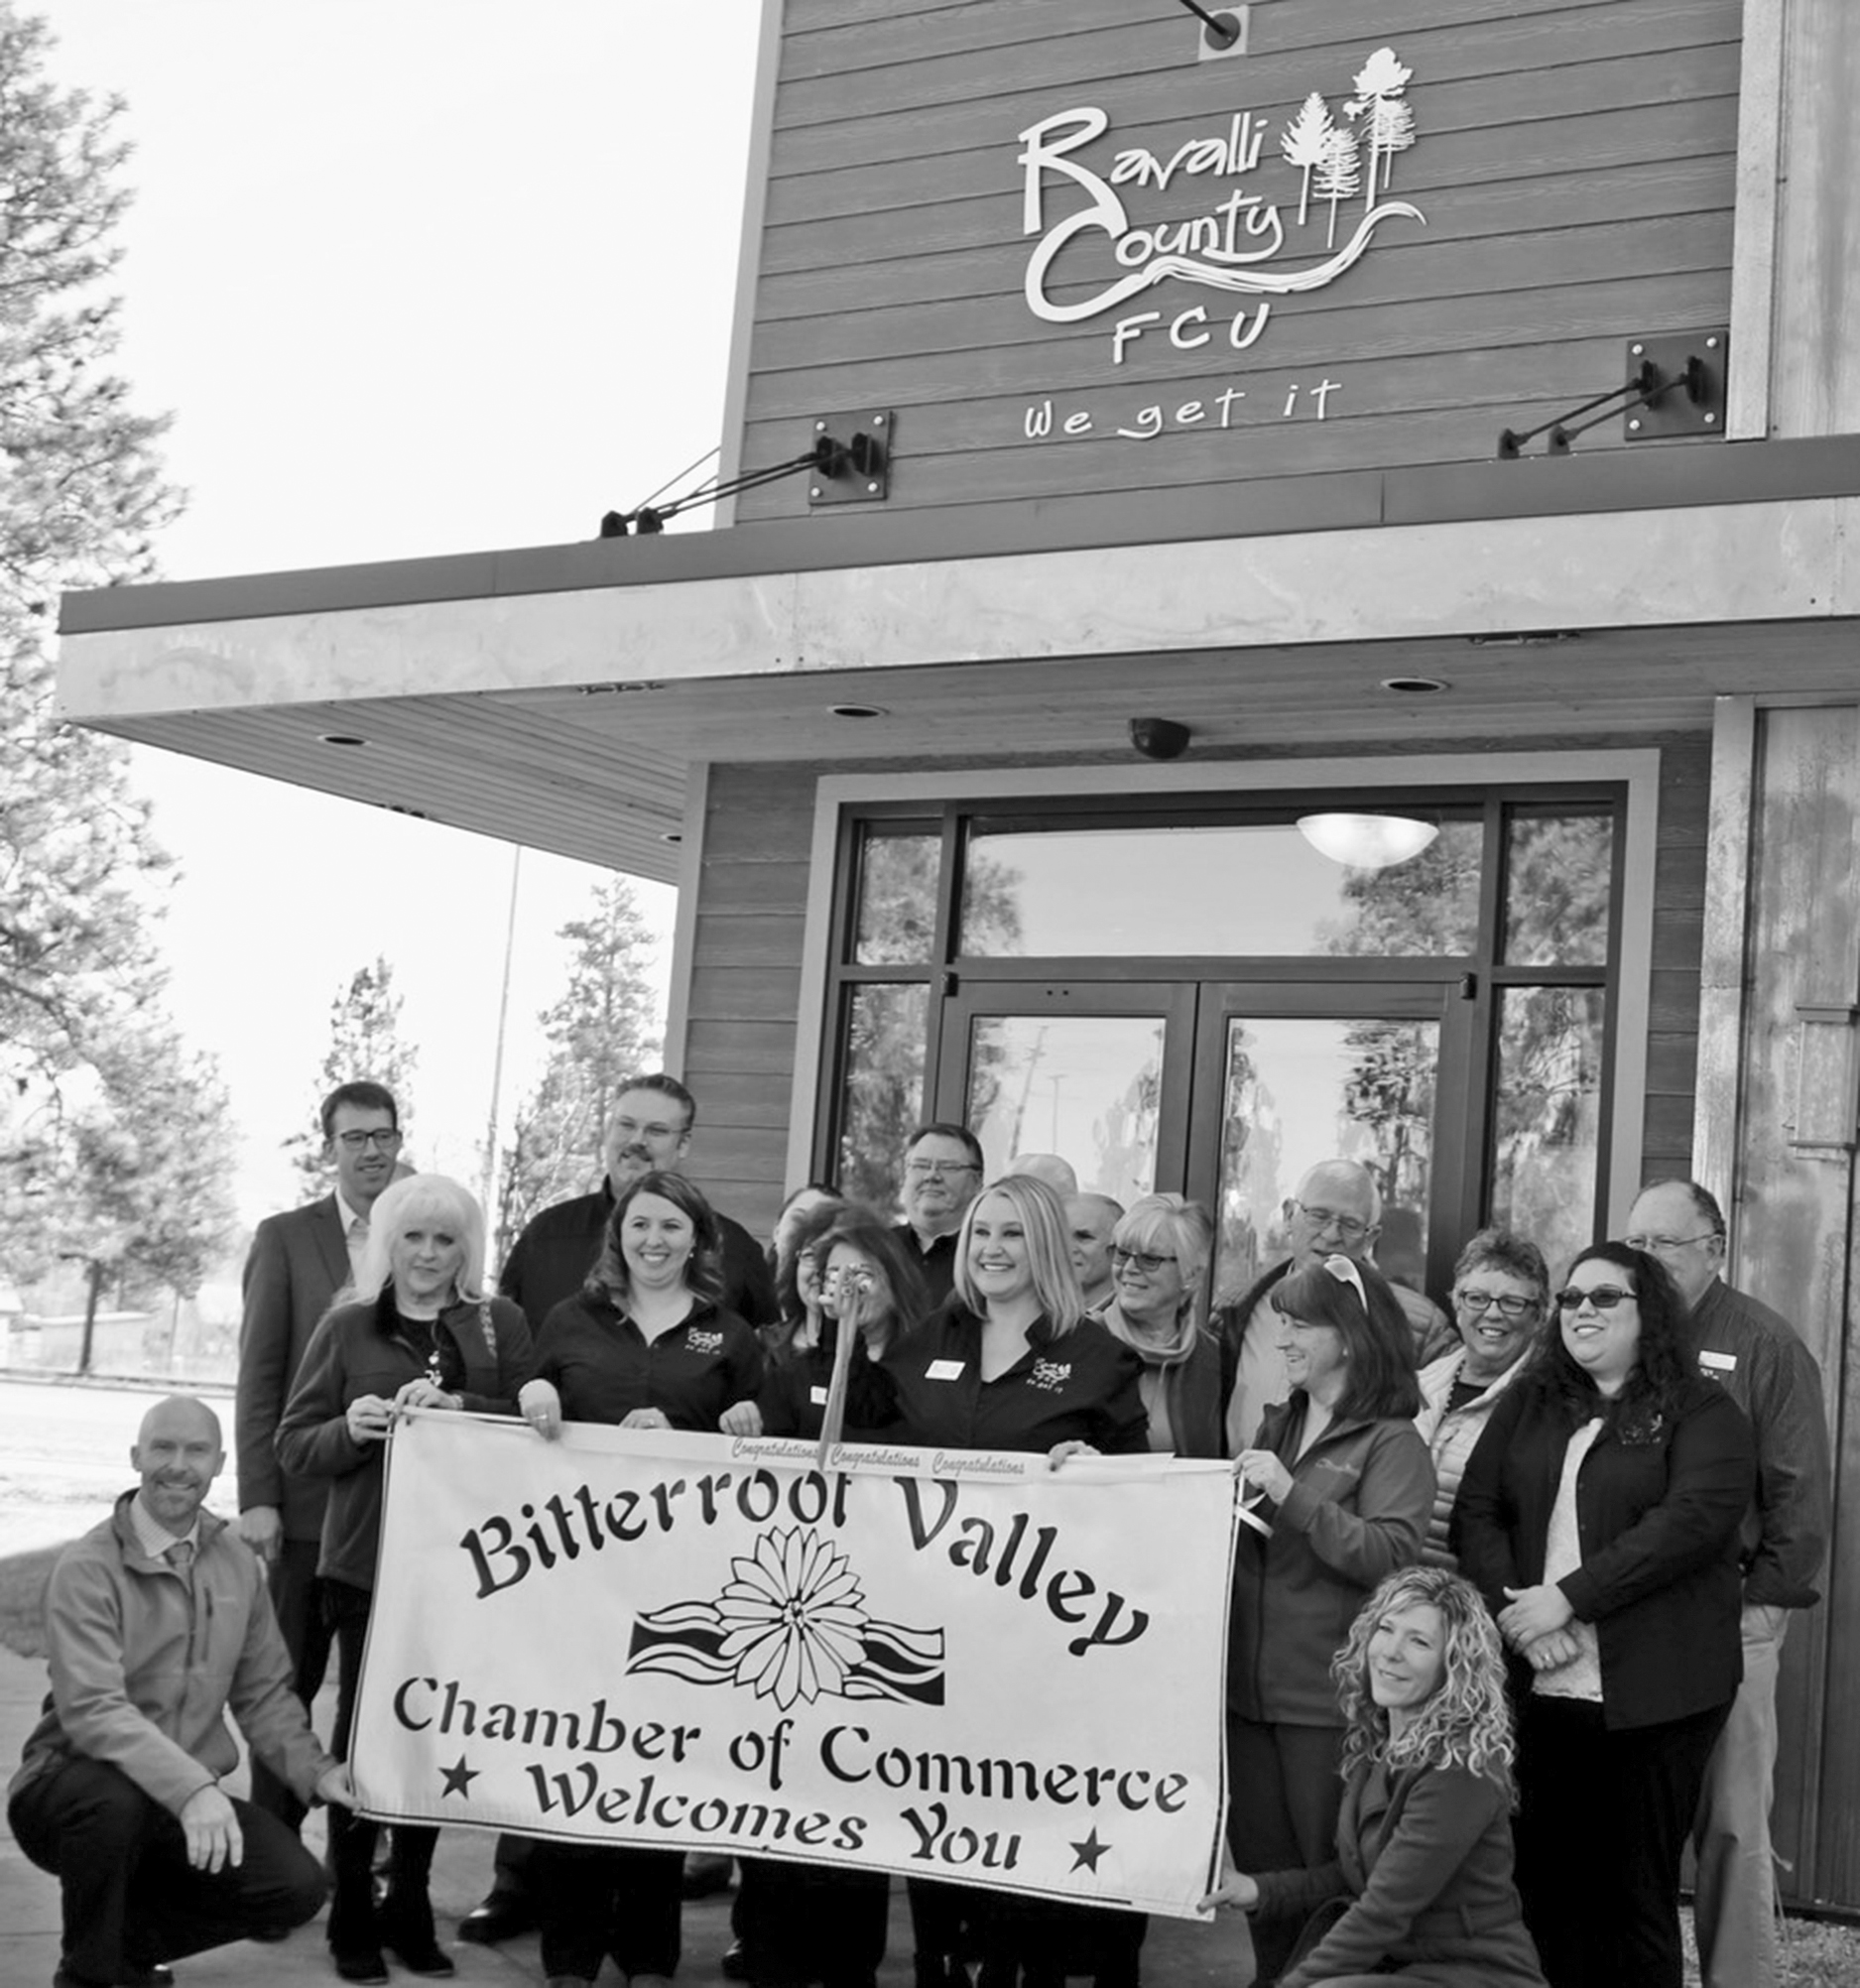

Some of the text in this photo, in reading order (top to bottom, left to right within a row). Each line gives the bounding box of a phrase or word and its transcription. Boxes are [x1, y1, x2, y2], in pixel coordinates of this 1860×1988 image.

[1018, 106, 1268, 235] Ravalli
[1025, 188, 1284, 322] County
[1112, 303, 1270, 364] FCU
[1025, 379, 1342, 439] We get it
[731, 1438, 1025, 1475] Congratulations Congratulations Congratulations
[459, 1468, 1151, 1658] Bitterroot Valley
[393, 1677, 1188, 1814] Chamber of Commerce
[524, 1762, 1022, 1871] Welcomes You
